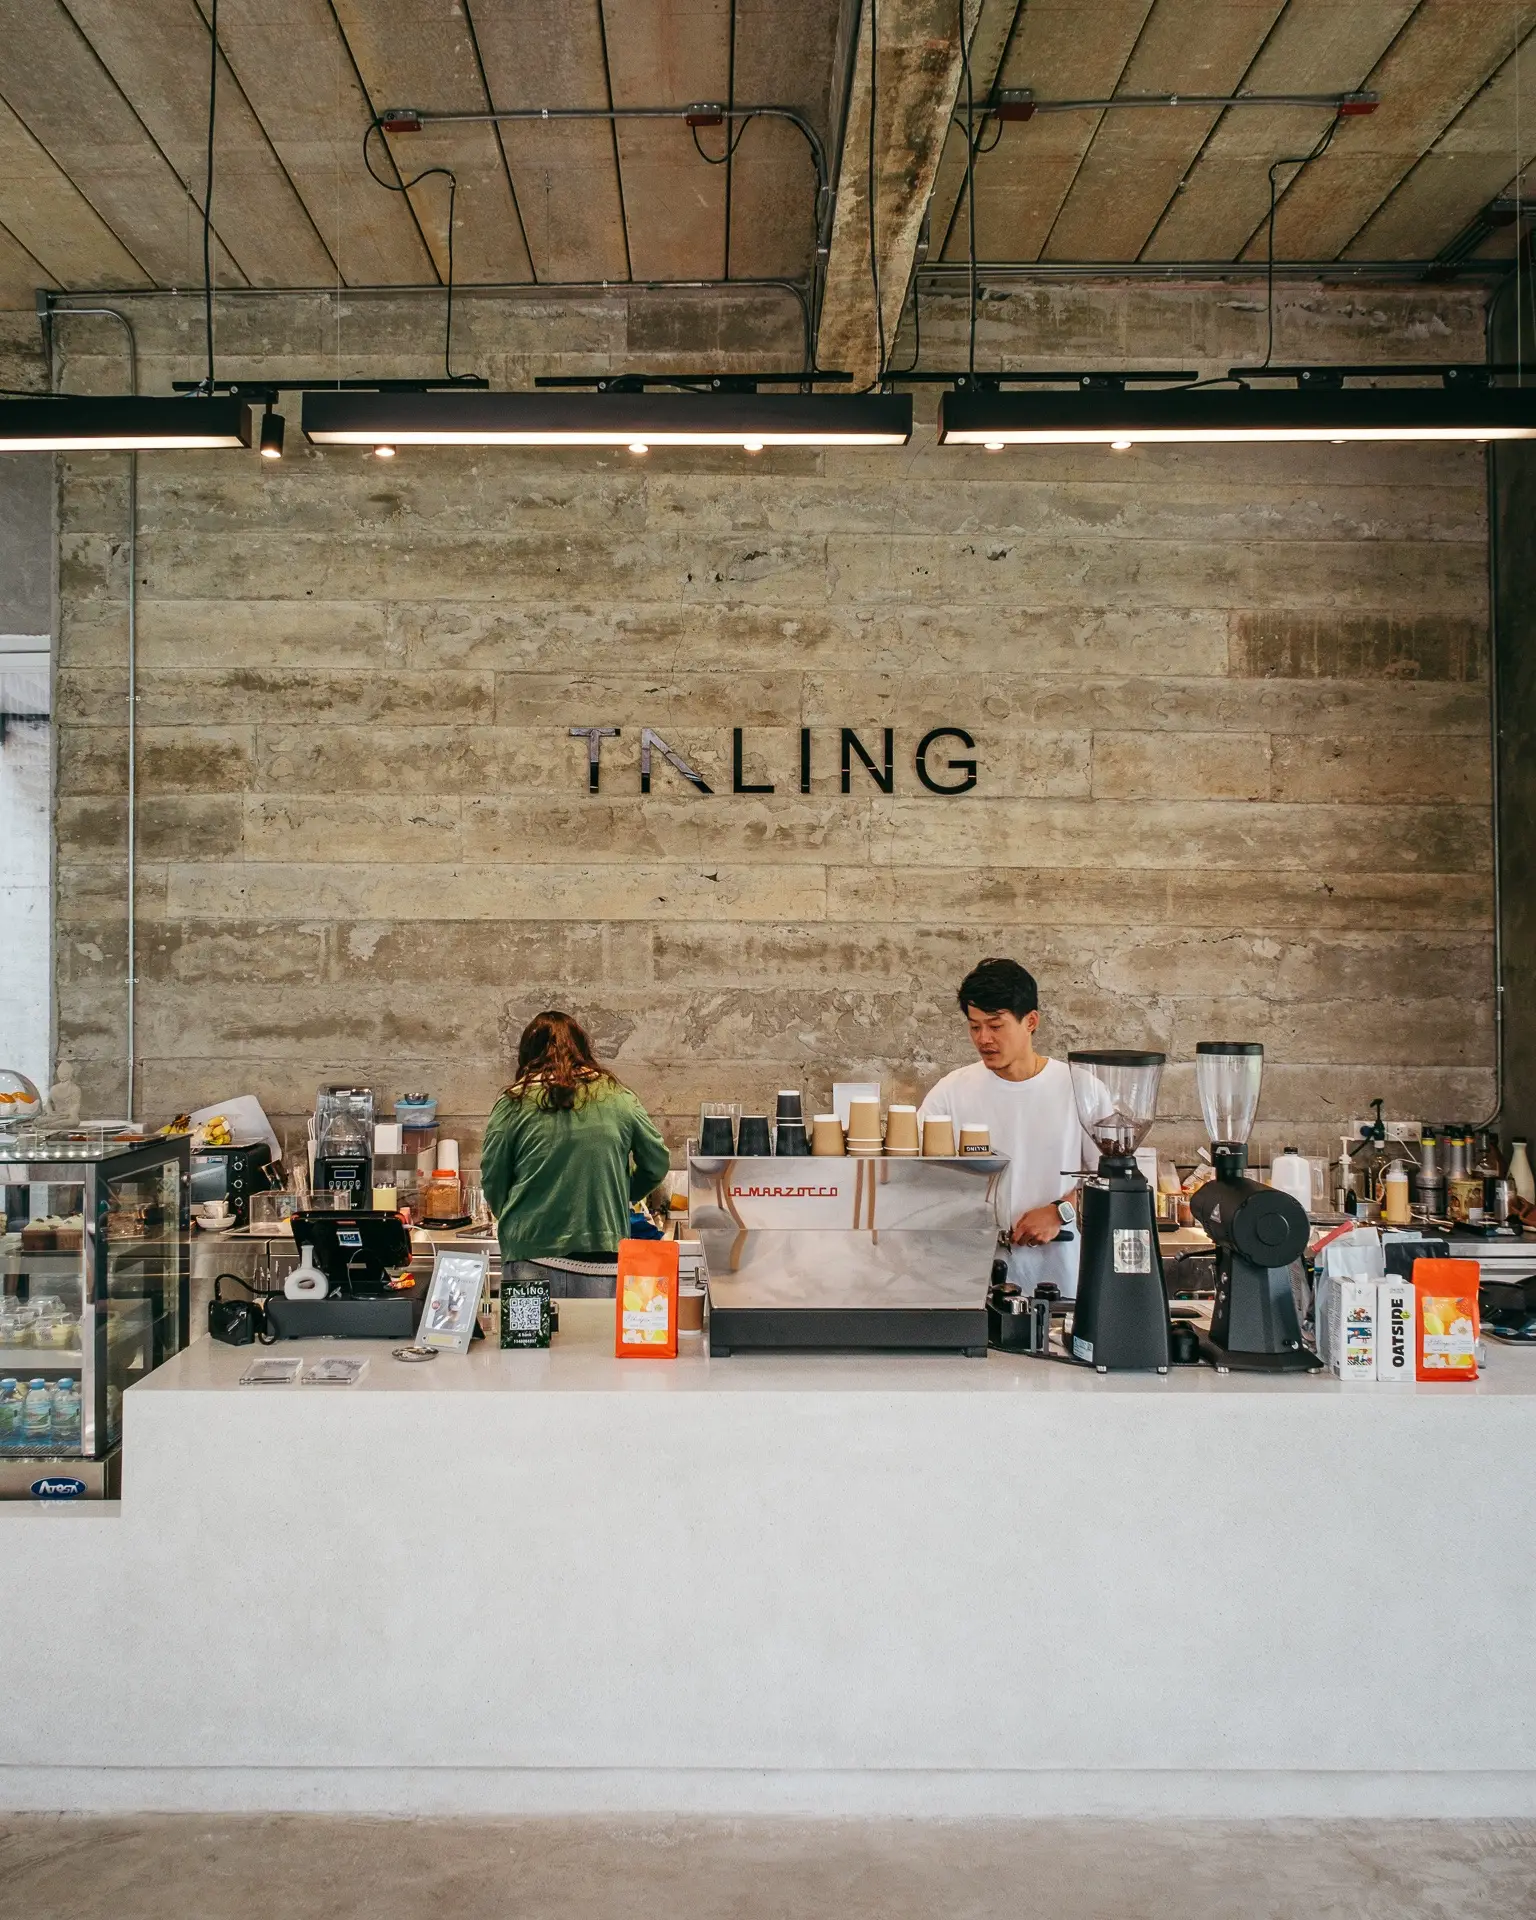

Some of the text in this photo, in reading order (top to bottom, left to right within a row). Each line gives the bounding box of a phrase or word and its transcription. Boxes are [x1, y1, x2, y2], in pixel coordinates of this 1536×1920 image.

[728, 1187, 838, 1197] LA MARZOCCO
[1391, 1298, 1405, 1368] OATSIDE
